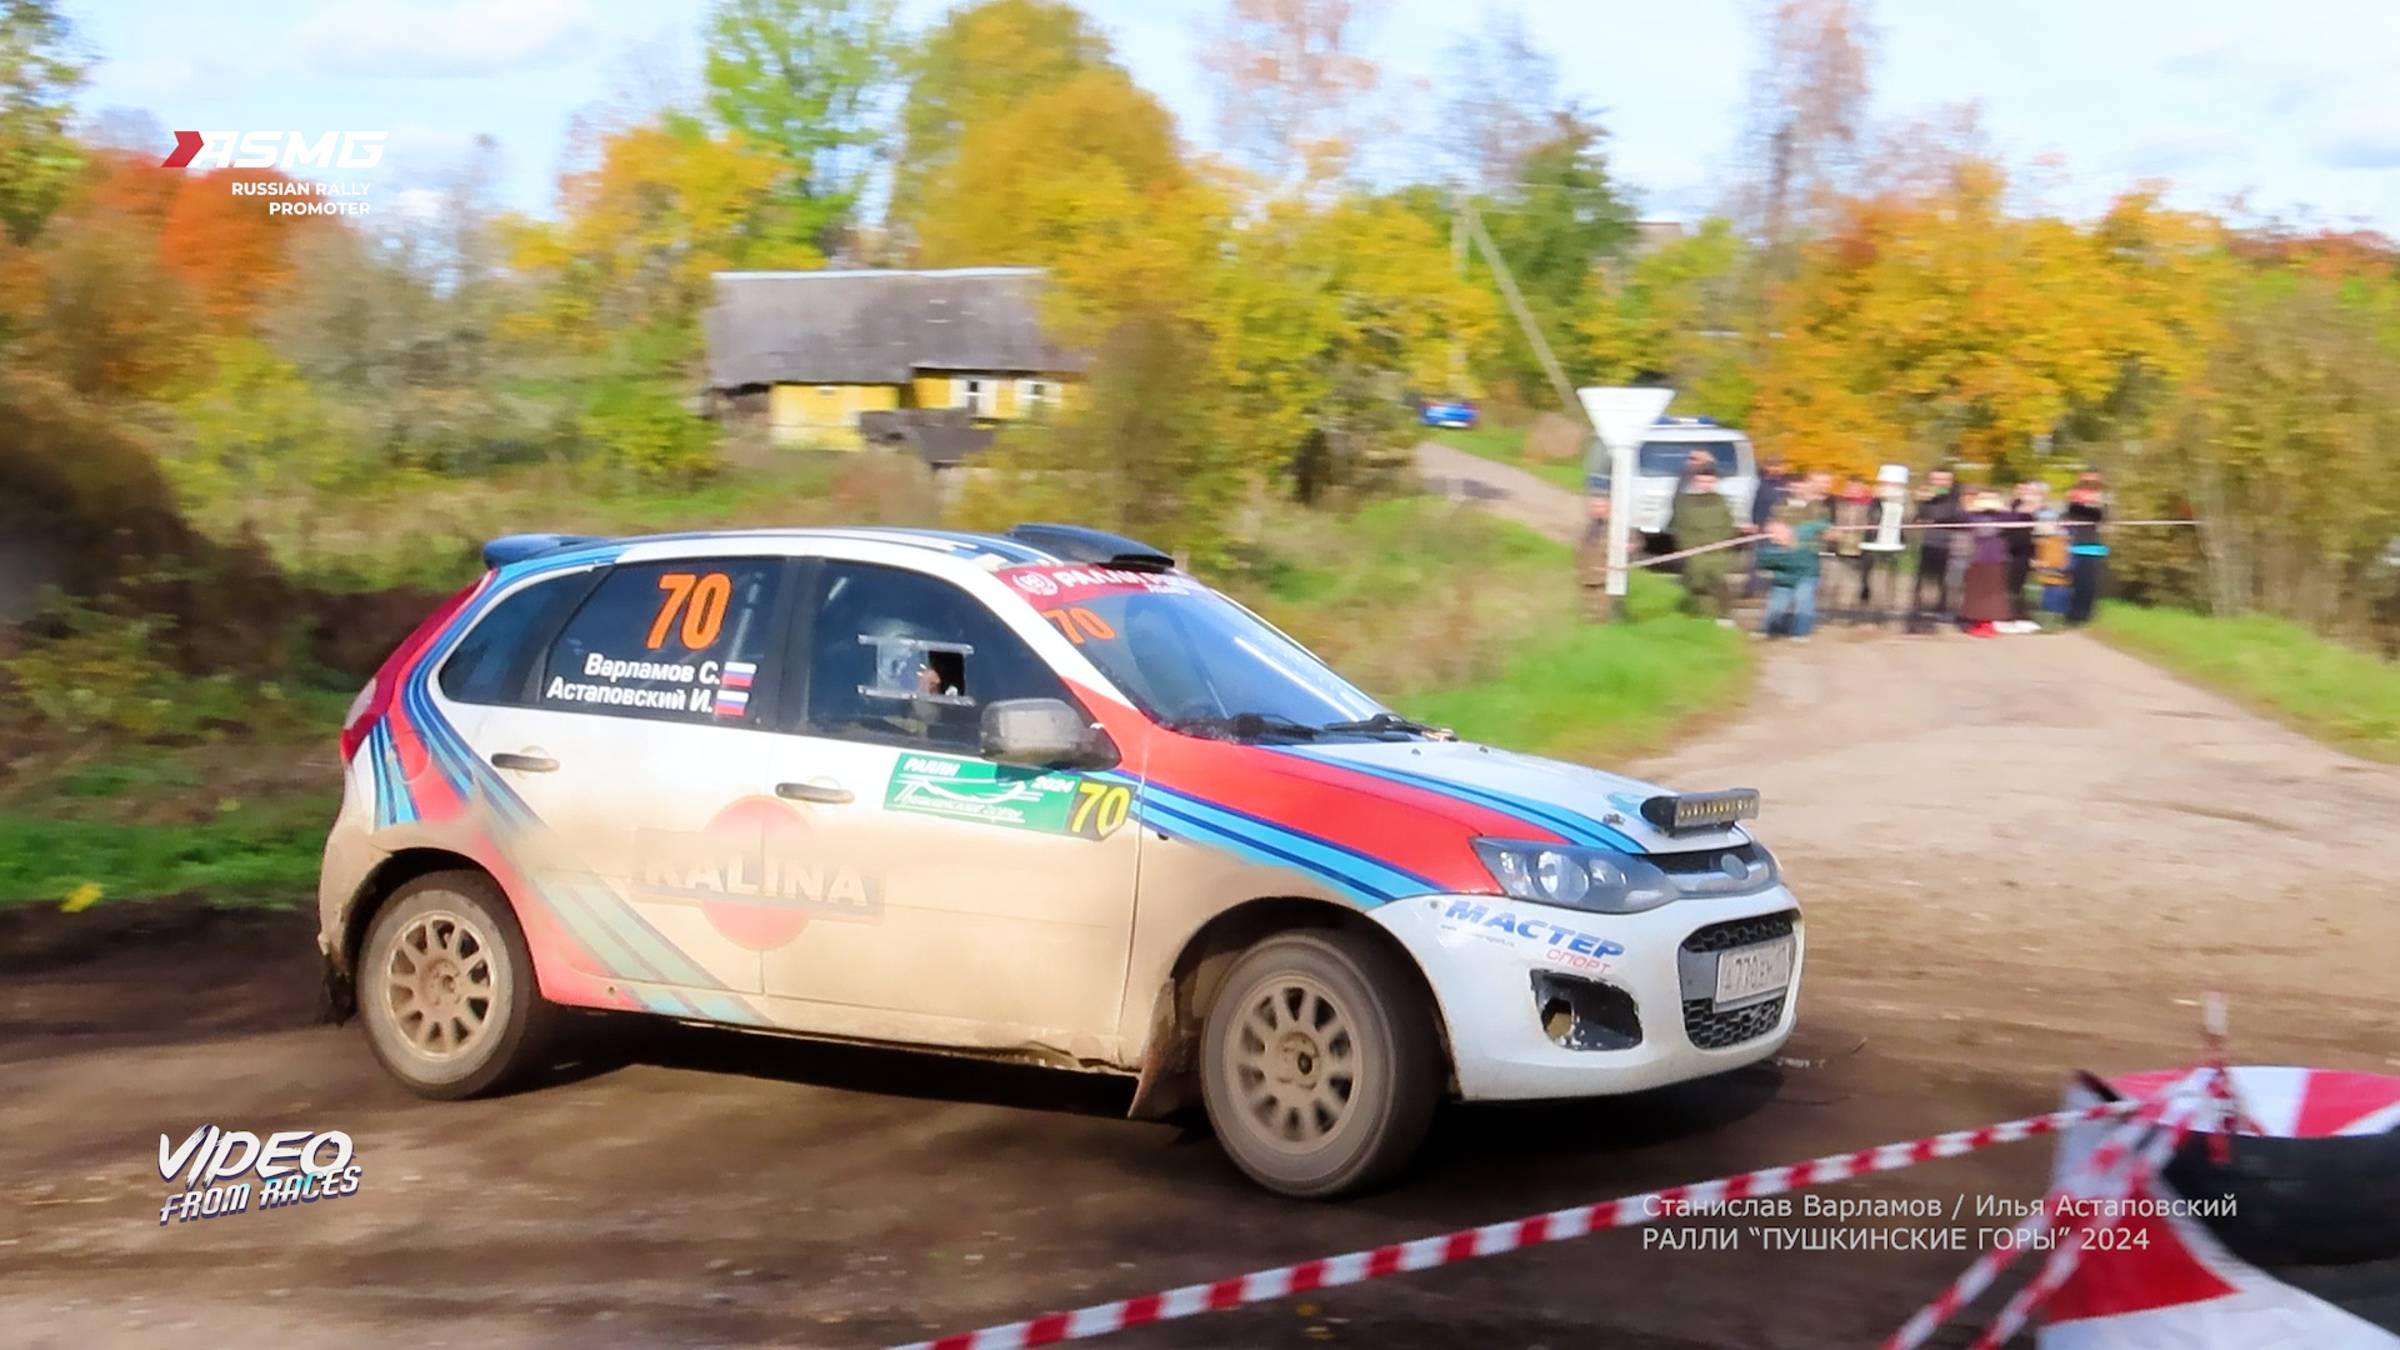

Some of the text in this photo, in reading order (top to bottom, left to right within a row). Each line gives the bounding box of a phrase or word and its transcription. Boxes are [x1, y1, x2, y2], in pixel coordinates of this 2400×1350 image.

[646, 571, 732, 650] 70
[1043, 607, 1115, 644] 70
[584, 653, 722, 686] Варламов С.
[547, 676, 714, 714] Астаповский И.
[1070, 780, 1133, 834] 70
[643, 855, 867, 906] KALINA
[1445, 900, 1625, 959] МАСТЕР
[1546, 949, 1612, 974] СПОРТ
